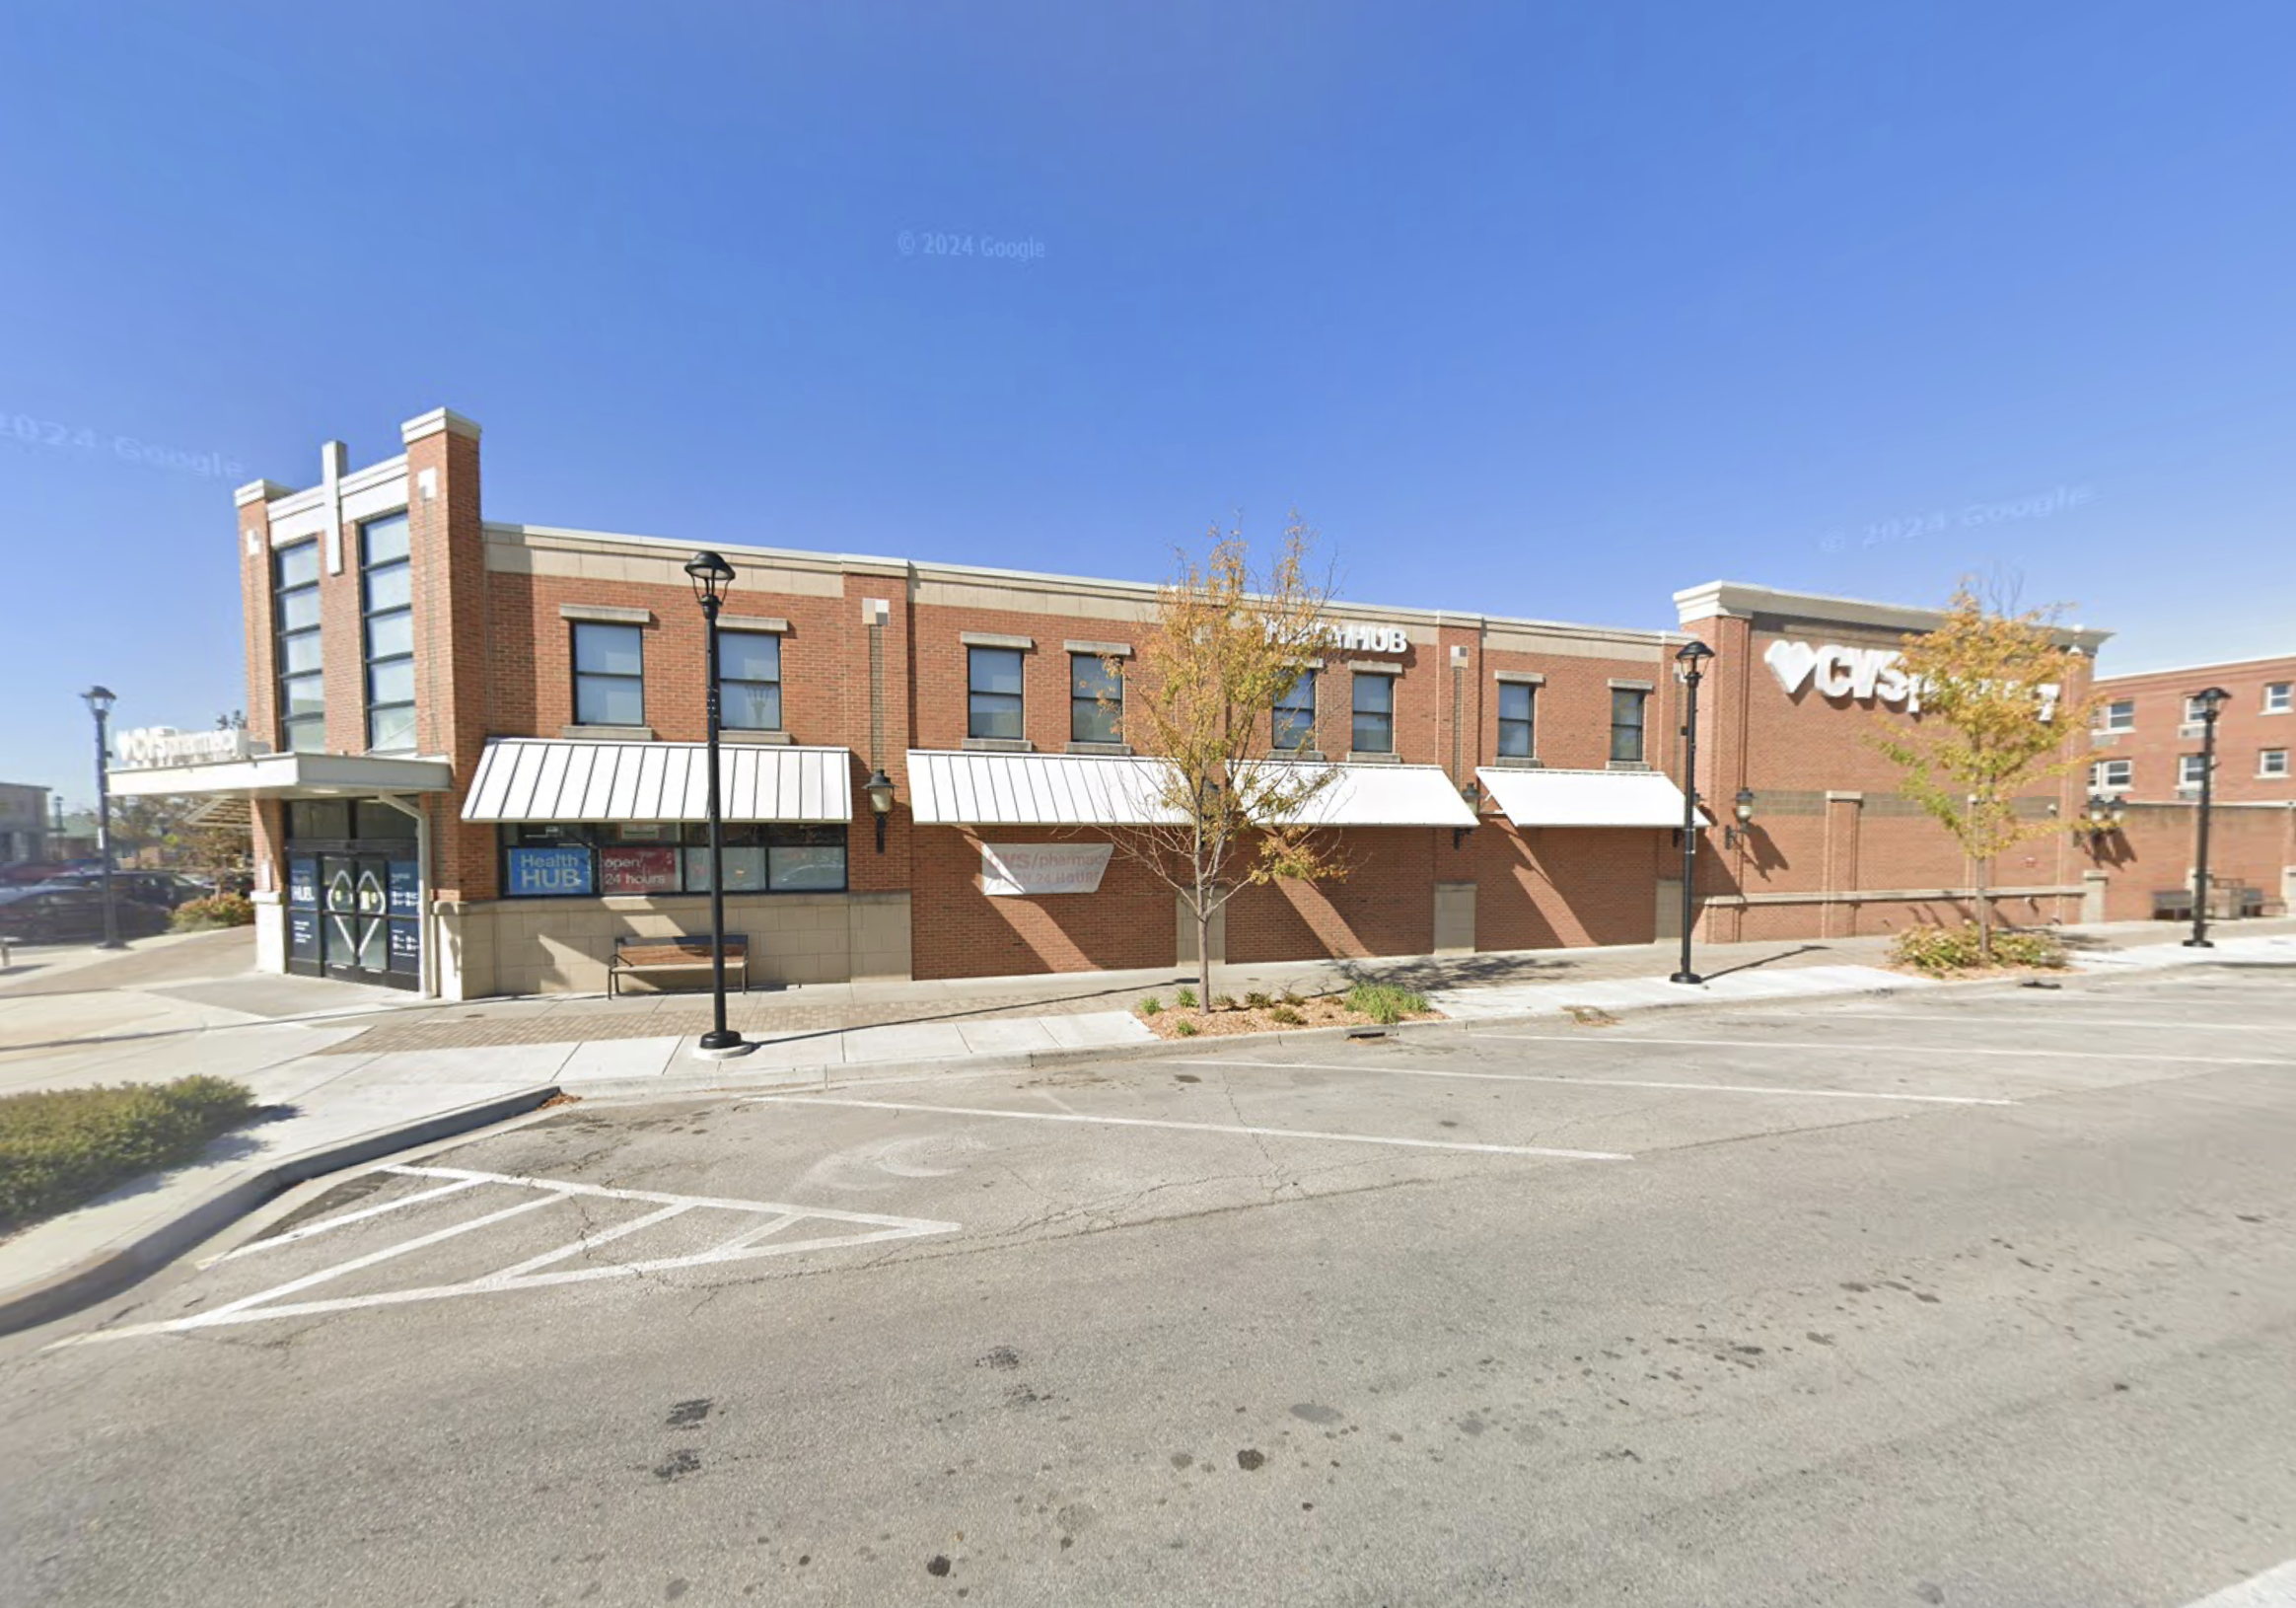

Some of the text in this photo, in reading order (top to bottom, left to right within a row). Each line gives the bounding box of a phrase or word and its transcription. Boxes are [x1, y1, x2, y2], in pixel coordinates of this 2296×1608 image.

[521, 853, 579, 868] Health
[604, 858, 641, 871] open
[521, 868, 580, 888] HUB
[605, 873, 665, 885] 24 hours
